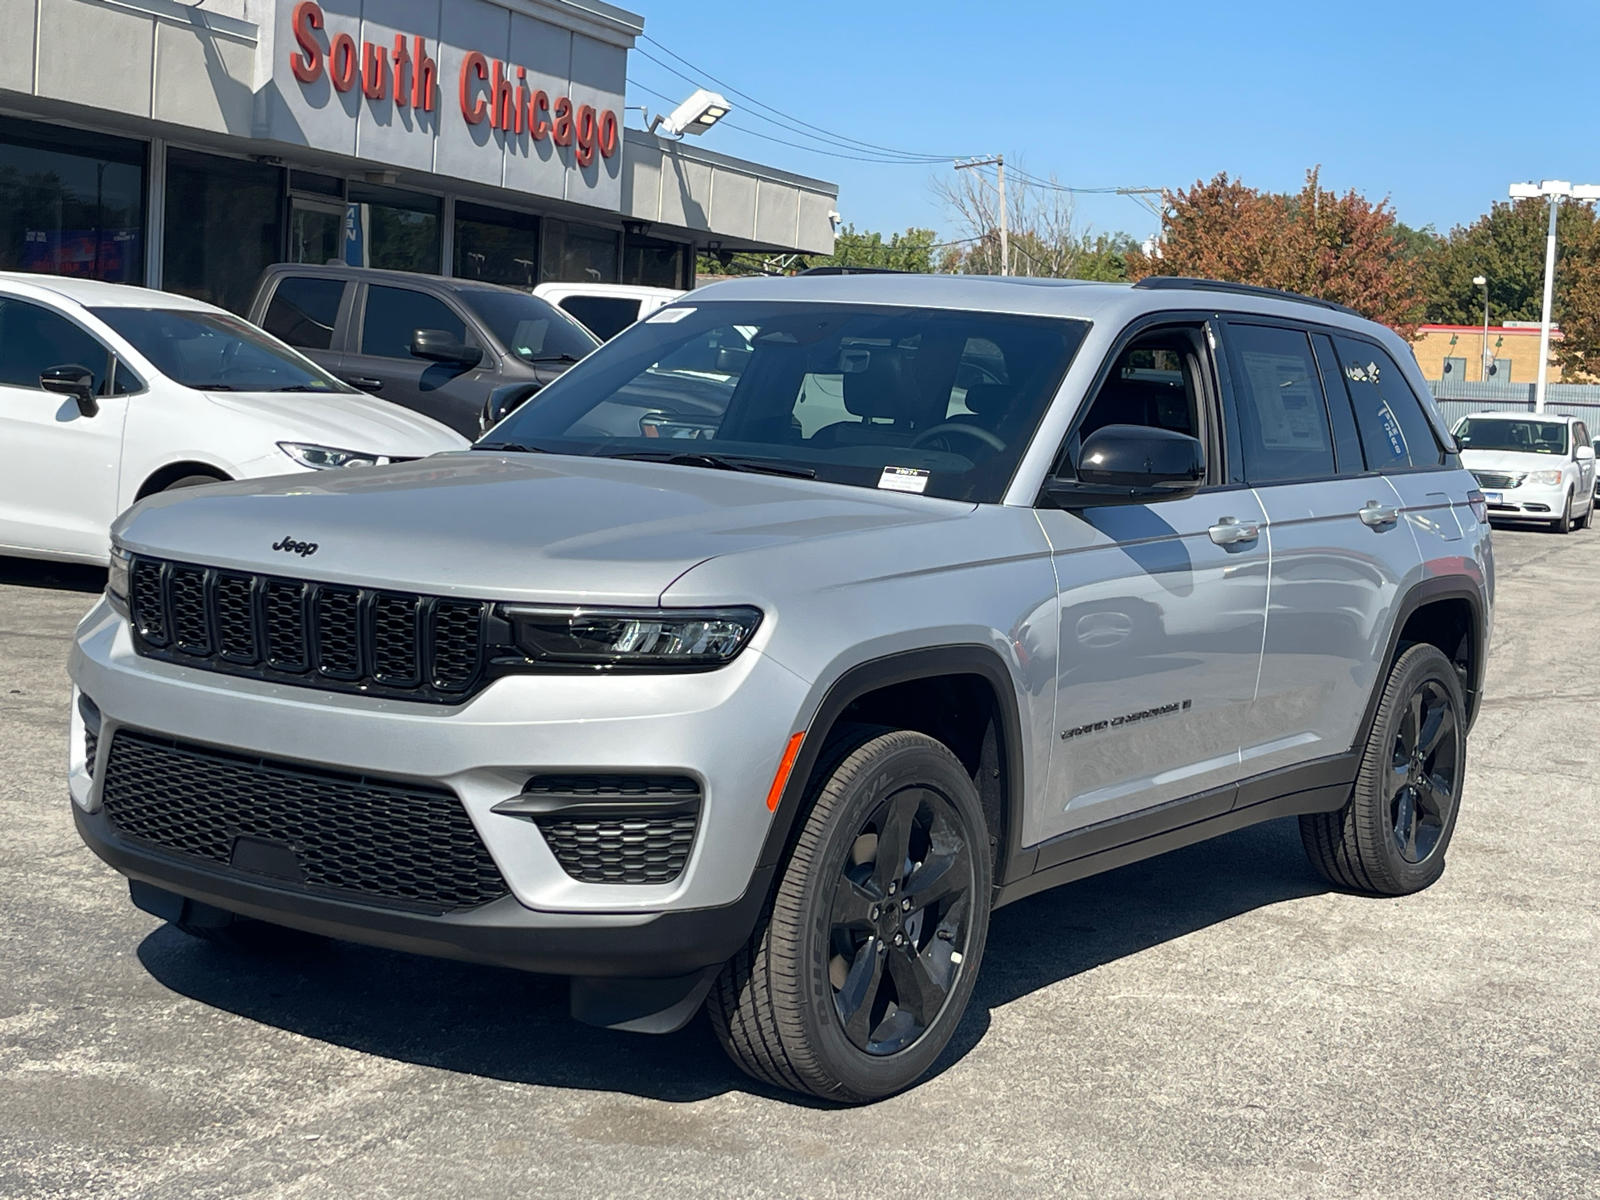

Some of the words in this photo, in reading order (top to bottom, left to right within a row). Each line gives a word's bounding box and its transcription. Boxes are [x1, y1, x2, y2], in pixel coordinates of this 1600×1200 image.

[290, 1, 437, 112] South
[459, 51, 618, 168] Chicago
[272, 535, 319, 558] Jeep
